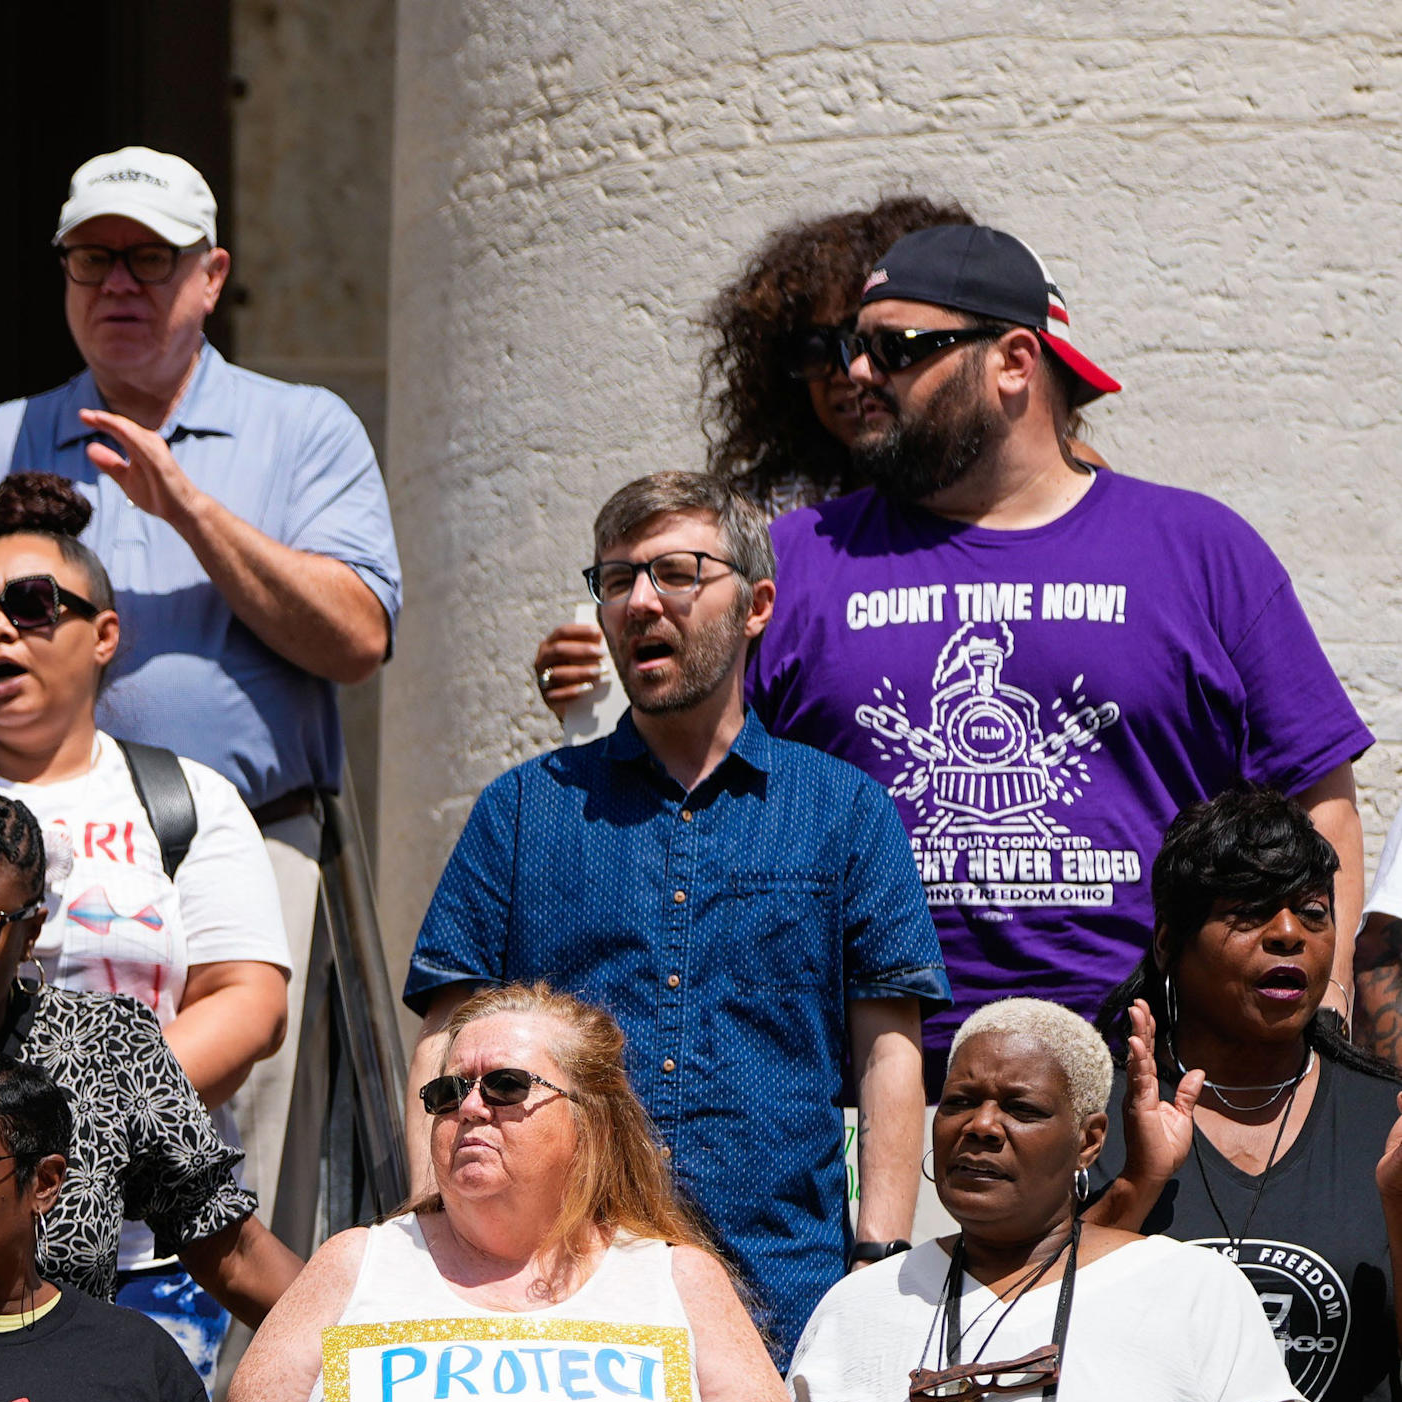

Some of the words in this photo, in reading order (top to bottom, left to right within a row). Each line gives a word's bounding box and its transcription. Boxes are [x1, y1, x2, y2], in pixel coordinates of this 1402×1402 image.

[846, 584, 947, 630] COUNT
[954, 582, 1033, 623] TIME
[1041, 583, 1126, 624] NOW!
[971, 726, 1004, 740] FILM
[926, 837, 953, 849] THE
[957, 836, 995, 849] DULY
[998, 836, 1092, 850] CONVICTED
[968, 849, 1052, 882] NEVER
[1061, 850, 1141, 883] ENDED
[968, 889, 1056, 901] FREEDOM
[1060, 889, 1105, 901] OHIO
[1258, 1247, 1342, 1321] FREEDOM
